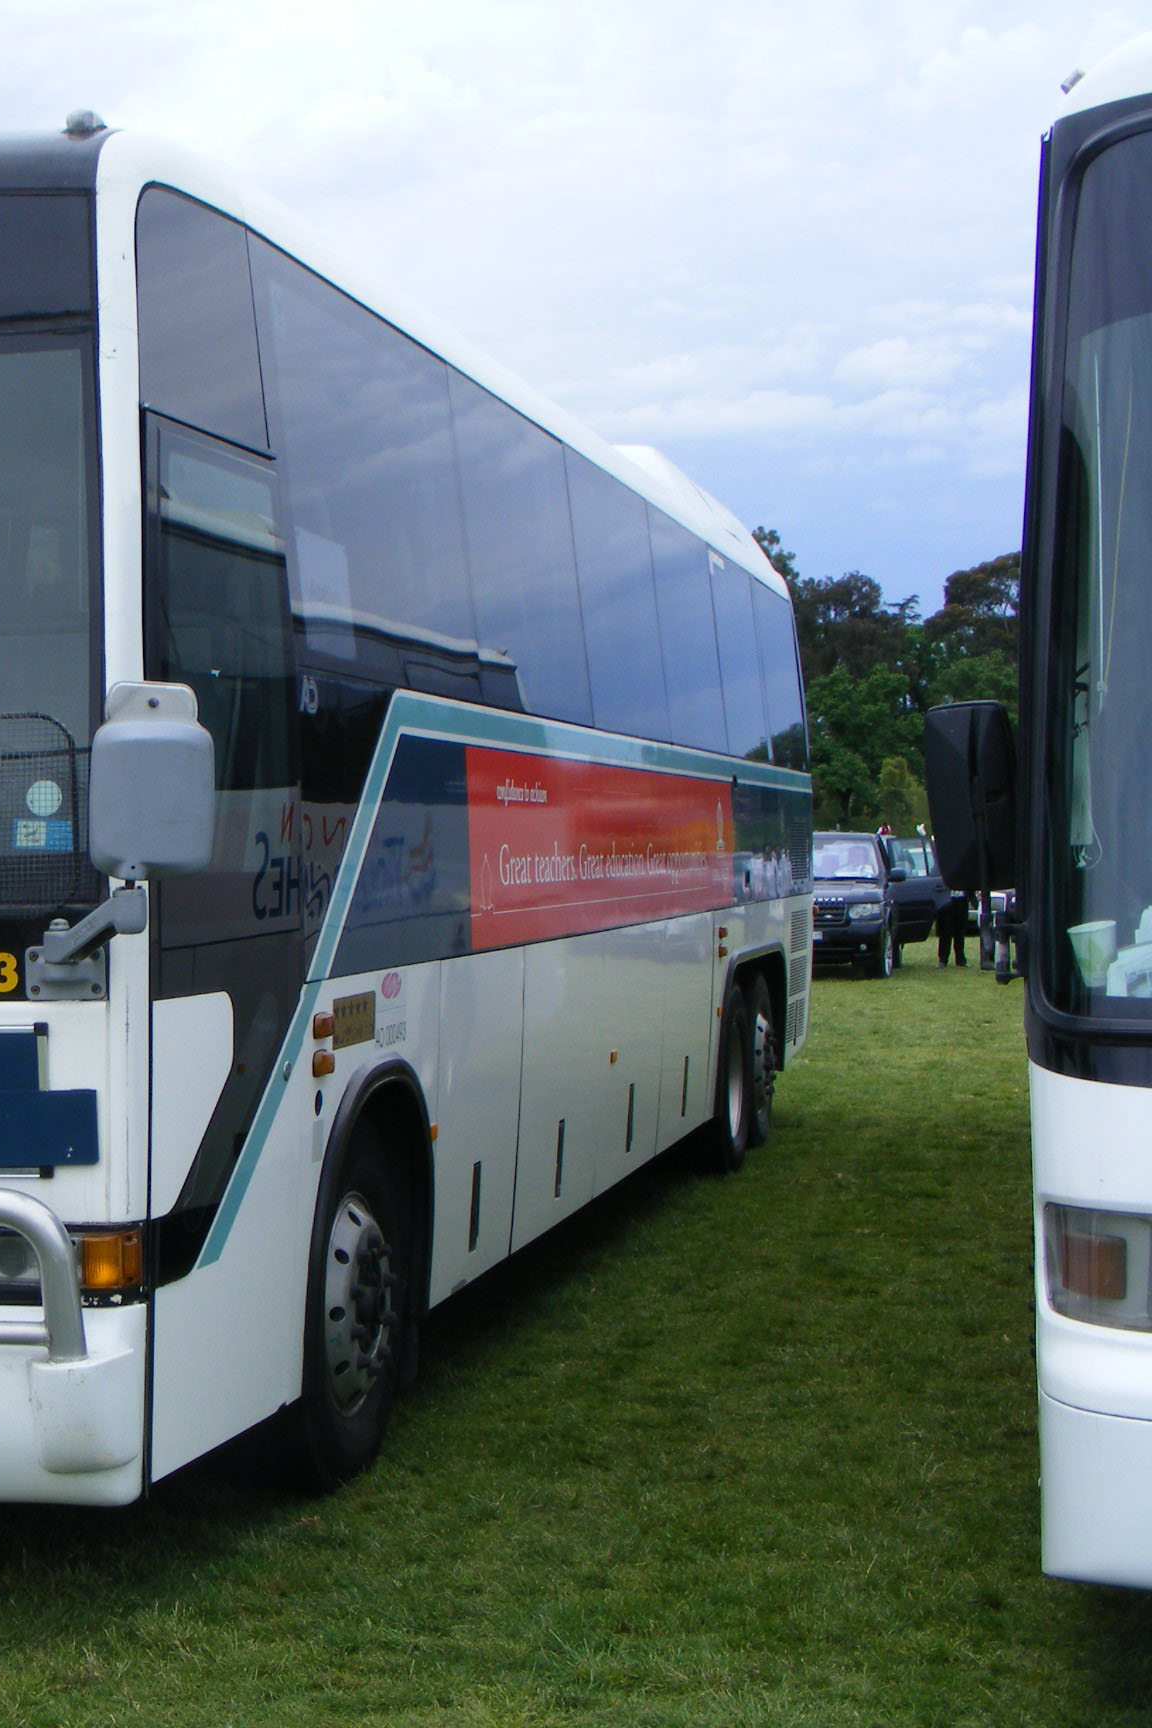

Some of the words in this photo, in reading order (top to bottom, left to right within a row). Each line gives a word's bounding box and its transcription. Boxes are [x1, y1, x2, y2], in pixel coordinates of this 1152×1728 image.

[499, 843, 532, 886] Great
[579, 843, 604, 880] Great
[646, 843, 667, 875] Great
